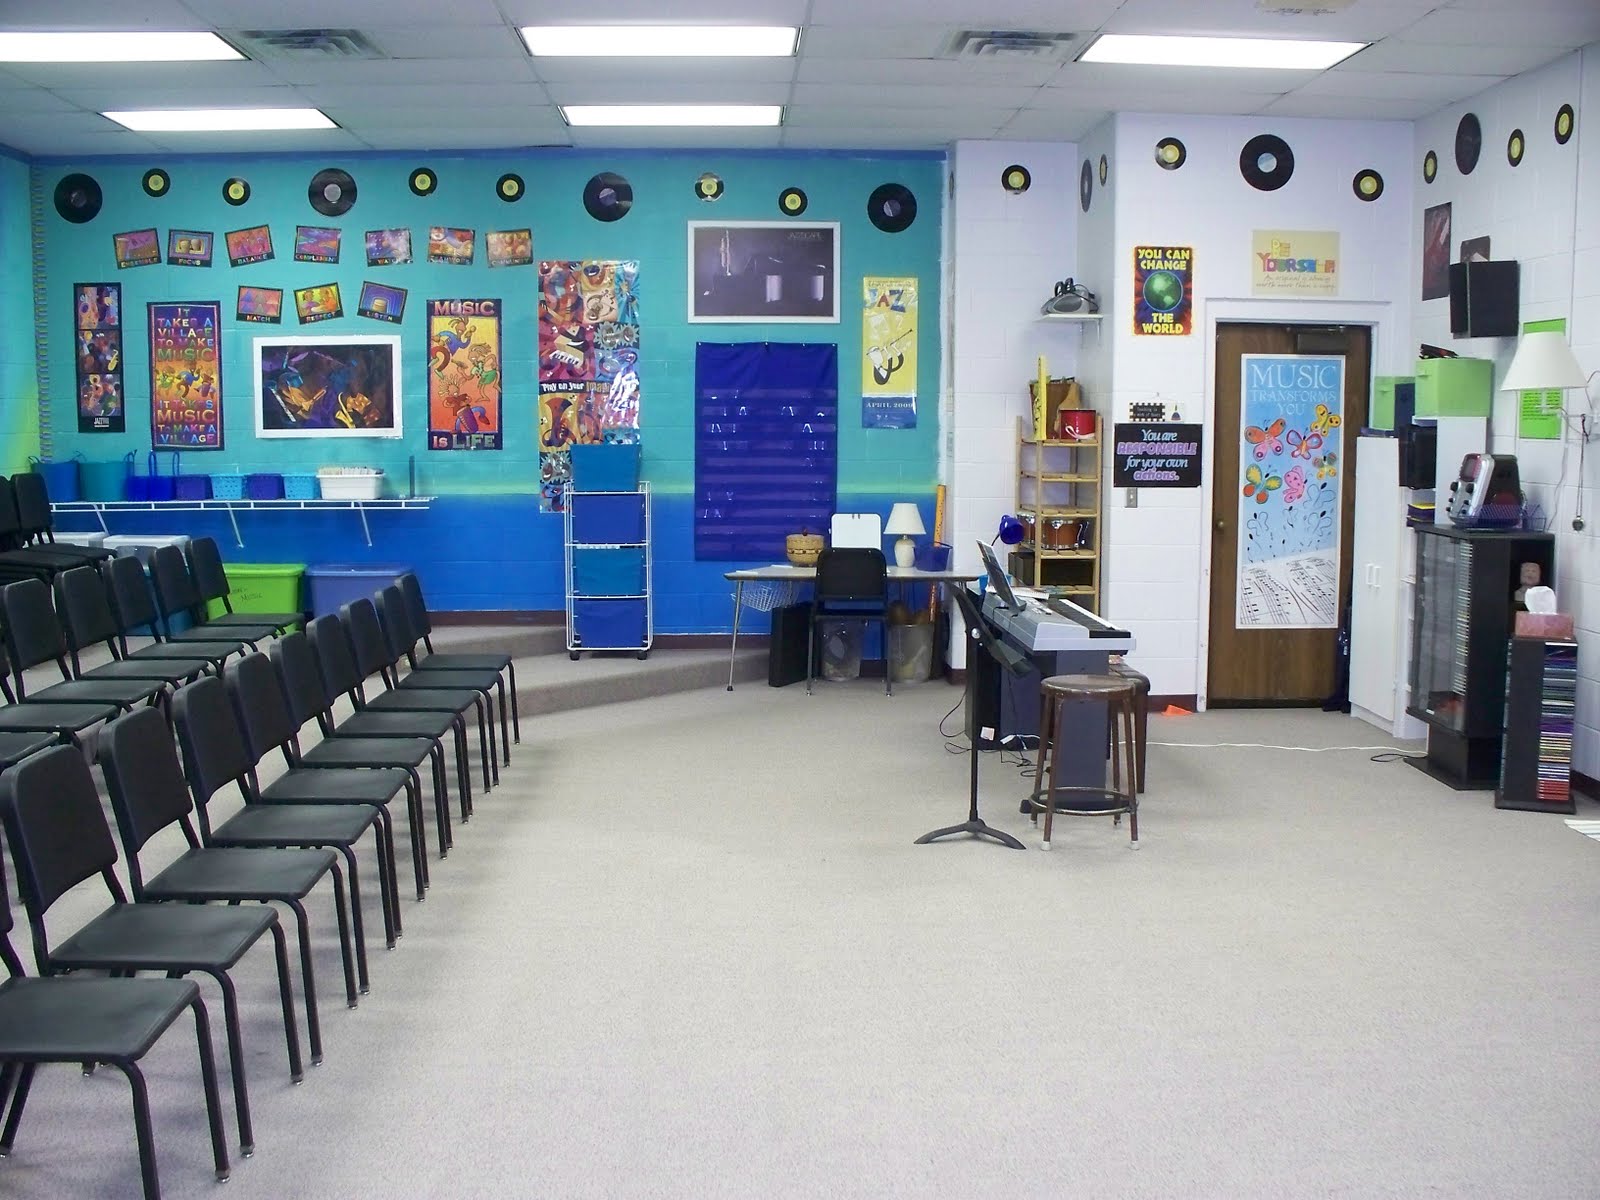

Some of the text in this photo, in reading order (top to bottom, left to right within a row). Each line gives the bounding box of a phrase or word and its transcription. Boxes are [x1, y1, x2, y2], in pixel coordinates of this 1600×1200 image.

[1138, 249, 1190, 260] YOU CAN
[1140, 260, 1186, 270] CHANGE
[178, 307, 190, 317] IT
[434, 301, 495, 316] MUSIC
[204, 317, 213, 327] A
[306, 311, 336, 323] RESPECT
[366, 311, 393, 322] LISTEN
[1152, 312, 1174, 323] THE
[157, 328, 213, 338] VILLAGE
[1142, 323, 1184, 334] WORLD
[157, 338, 214, 347] TO MAKE
[157, 348, 215, 362] MUSIC
[1250, 363, 1337, 389] MUSIC
[1248, 389, 1337, 402] TRANSFORMS
[160, 400, 170, 409] IT
[1277, 403, 1306, 416] YOU
[157, 409, 215, 423] MUSIC
[173, 424, 205, 432] MAKE
[208, 424, 216, 433] A
[160, 434, 215, 443] VILLAGE
[452, 433, 495, 448] LIFE
[1141, 429, 1178, 441] You are
[1117, 442, 1198, 456] RESPONSIBLE
[1124, 455, 1188, 472] for your own
[1133, 467, 1180, 481] actions.
